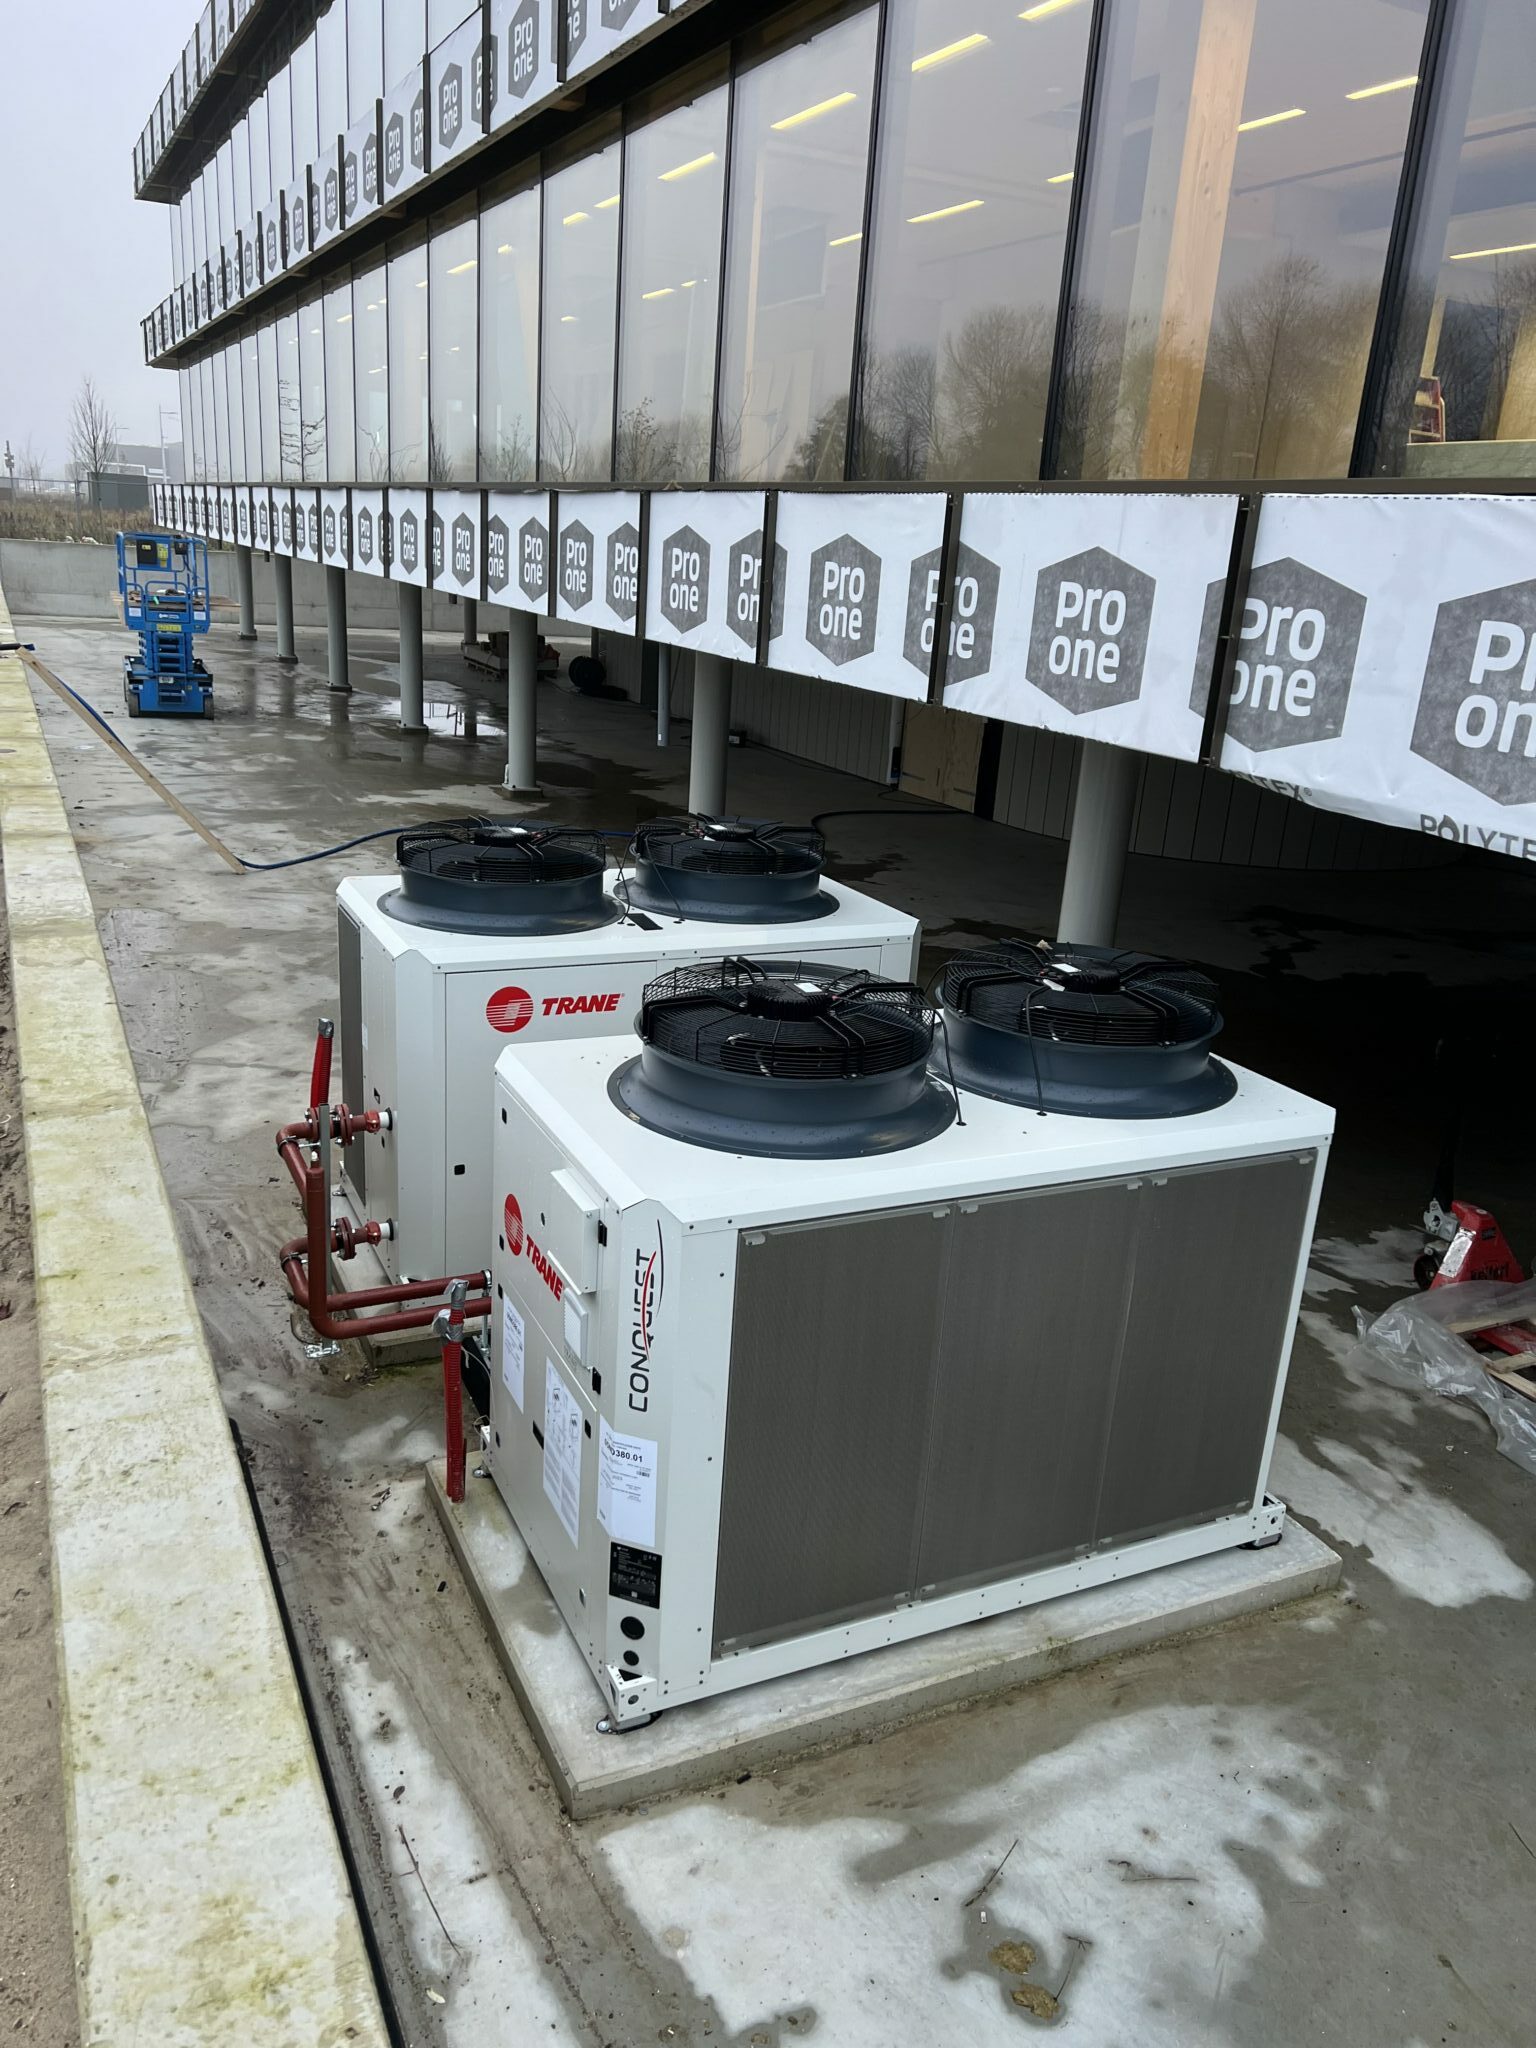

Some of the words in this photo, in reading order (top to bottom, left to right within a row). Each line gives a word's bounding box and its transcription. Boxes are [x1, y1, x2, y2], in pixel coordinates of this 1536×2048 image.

[514, 17, 533, 55] Pro
[513, 47, 533, 82] one
[443, 79, 458, 111] Pro
[443, 105, 458, 134] one
[432, 527, 441, 546] ro
[456, 527, 470, 551] Pro
[488, 531, 504, 556] Pro
[524, 534, 543, 561] Pro
[432, 548, 441, 566] ne
[456, 552, 471, 572] one
[488, 557, 504, 578] one
[566, 538, 587, 567] Pro
[614, 542, 639, 574] Pro
[671, 548, 700, 581] Pro
[524, 562, 543, 585] one
[565, 568, 587, 593] one
[740, 554, 762, 589] Pr
[823, 561, 865, 603] Pro
[613, 575, 638, 602] one
[669, 582, 699, 612] one
[737, 592, 760, 623] on
[819, 603, 863, 641] one
[1055, 581, 1127, 636] Pro
[1048, 635, 1121, 684] one
[1455, 694, 1536, 758] on
[526, 1233, 563, 1302] TRANE
[629, 1248, 655, 1412] CONQUEST
